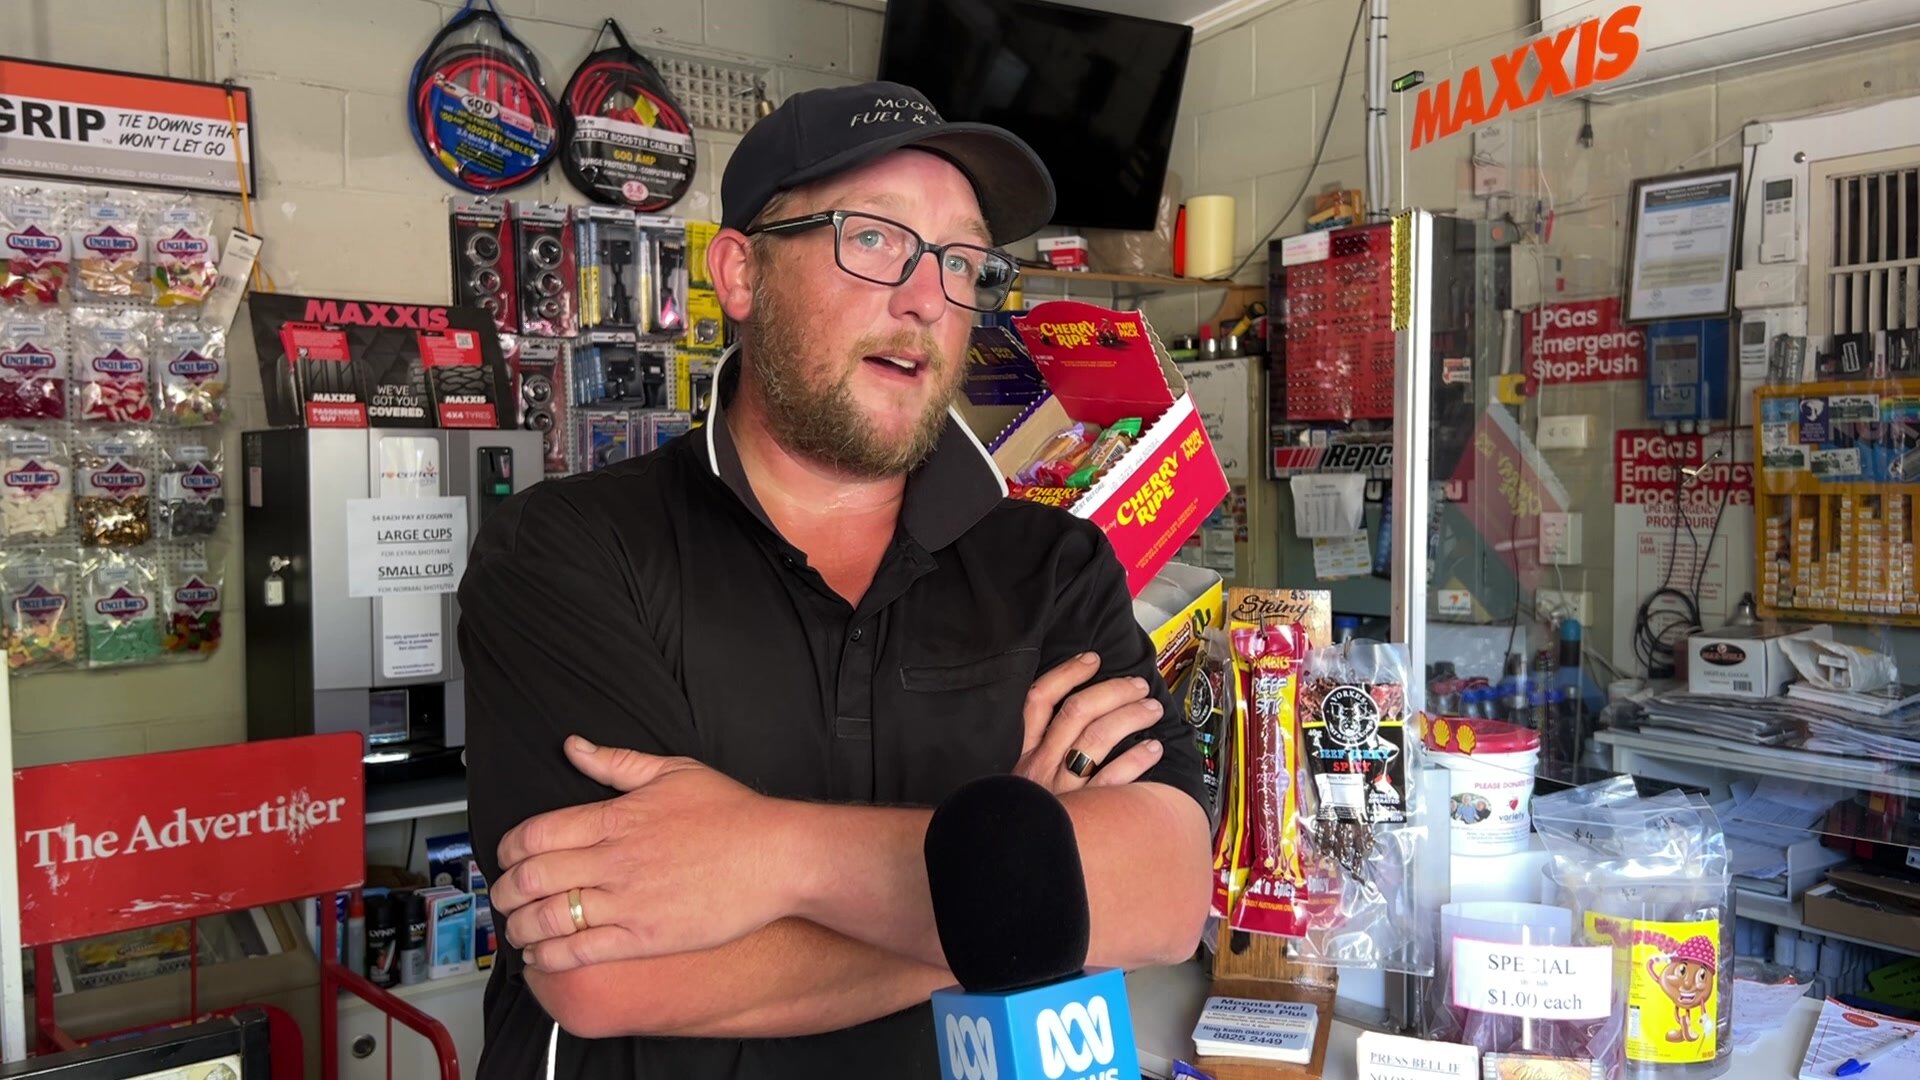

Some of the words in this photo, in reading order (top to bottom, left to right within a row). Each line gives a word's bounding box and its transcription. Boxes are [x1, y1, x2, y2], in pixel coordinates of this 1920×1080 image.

[1410, 5, 1642, 150] MAXXIS
[467, 99, 493, 115] 400
[118, 114, 141, 129] TIE
[147, 116, 202, 135] DOWNS
[850, 112, 904, 127] FUEL
[912, 114, 927, 125] &
[119, 134, 170, 150] WON'T
[174, 138, 202, 154] LET
[204, 142, 225, 156] GO
[610, 133, 648, 147] BOOSTER
[649, 140, 679, 154] CABLES
[613, 149, 633, 161] 600
[635, 153, 656, 165] AMP
[2, 158, 32, 168] LOAD
[34, 161, 69, 172] RATED
[72, 165, 95, 175] AND
[96, 167, 136, 179] TAGGED
[139, 171, 159, 181] FOR
[161, 173, 222, 187] COMMERCIAL
[303, 298, 449, 329] MAXXIS
[1532, 309, 1598, 330] LPGas
[1040, 320, 1096, 337] CHERRY
[1056, 333, 1091, 349] RIPE
[1532, 354, 1639, 381] Stop:Push
[313, 393, 356, 403] MAXXIS
[377, 385, 409, 395] WE'VE
[372, 396, 393, 407] GOT
[396, 396, 418, 407] YOU
[445, 395, 486, 404] MAXXIS
[465, 411, 491, 419] TYRES
[1179, 428, 1201, 452] TWIN
[1621, 437, 1697, 458] LPGas
[1184, 438, 1205, 462] PACK
[1026, 486, 1082, 499] CHERRY
[1116, 451, 1180, 526] CHERRY
[1621, 484, 1750, 504] Procedure
[1072, 499, 1086, 515] BEST
[1085, 482, 1106, 502] BEFORE
[1136, 484, 1176, 526] RIPE
[1646, 515, 1717, 529] PROCEDURE
[377, 529, 420, 541] LARGE
[423, 527, 453, 540] CUPS
[378, 565, 421, 577] SMALL
[424, 563, 454, 575] CUPS
[1232, 594, 1310, 621] Steiny
[1502, 780, 1526, 789] DONATE
[1498, 812, 1525, 823] variety
[25, 823, 119, 868] The
[123, 796, 345, 854] Advertiser
[1220, 999, 1271, 1009] Moonta
[1275, 1003, 1304, 1011] Fuel
[1487, 988, 1538, 1008] $1.00
[1543, 993, 1582, 1010] each
[1241, 1006, 1275, 1015] Tyres
[1203, 1025, 1221, 1033] Ring
[1213, 1032, 1246, 1041] 8825
[1249, 1035, 1283, 1045] 2449
[1370, 1051, 1408, 1066] PRESS
[1412, 1058, 1445, 1070] BELL
[1448, 1062, 1461, 1072] IF
